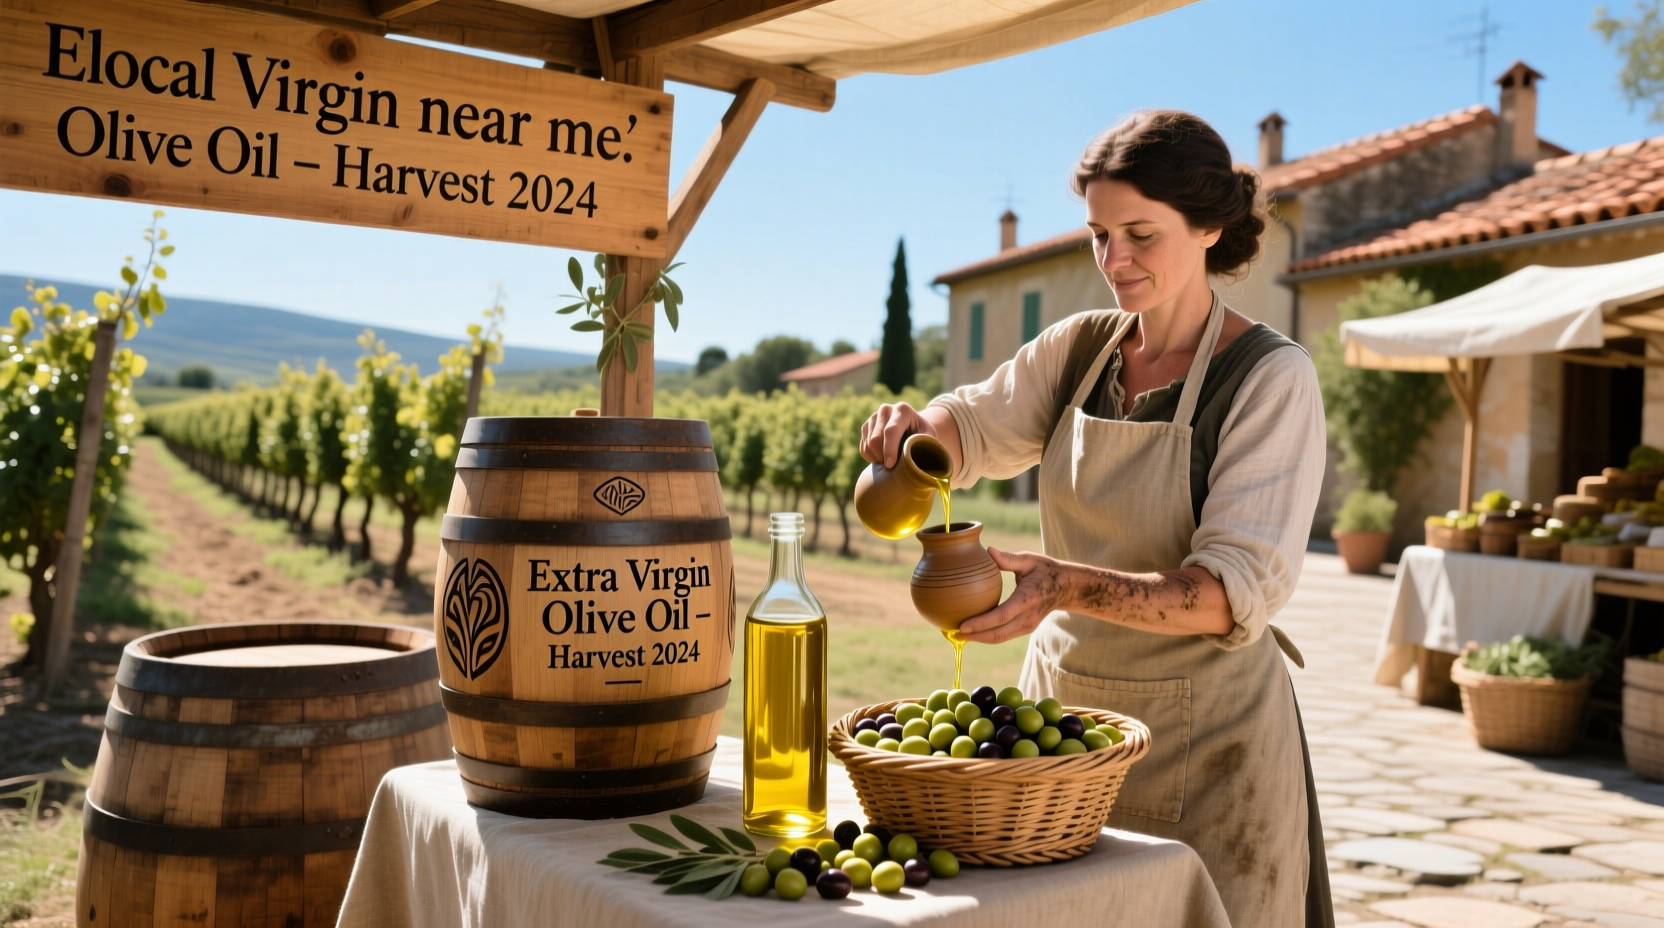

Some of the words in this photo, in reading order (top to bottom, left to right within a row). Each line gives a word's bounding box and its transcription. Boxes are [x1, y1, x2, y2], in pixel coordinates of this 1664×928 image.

[42, 21, 217, 102] Elocal
[232, 51, 400, 136] Virgin
[418, 97, 533, 147] near
[57, 105, 194, 169] Olive
[207, 125, 280, 180] Oil
[332, 143, 497, 208] Harvest
[506, 170, 599, 220] 2024
[526, 558, 620, 593] Extra
[625, 556, 712, 599] Virgin
[541, 599, 637, 636] Olive
[644, 597, 691, 634] Oil
[547, 642, 647, 670] Harvest
[650, 639, 701, 667] 2024
